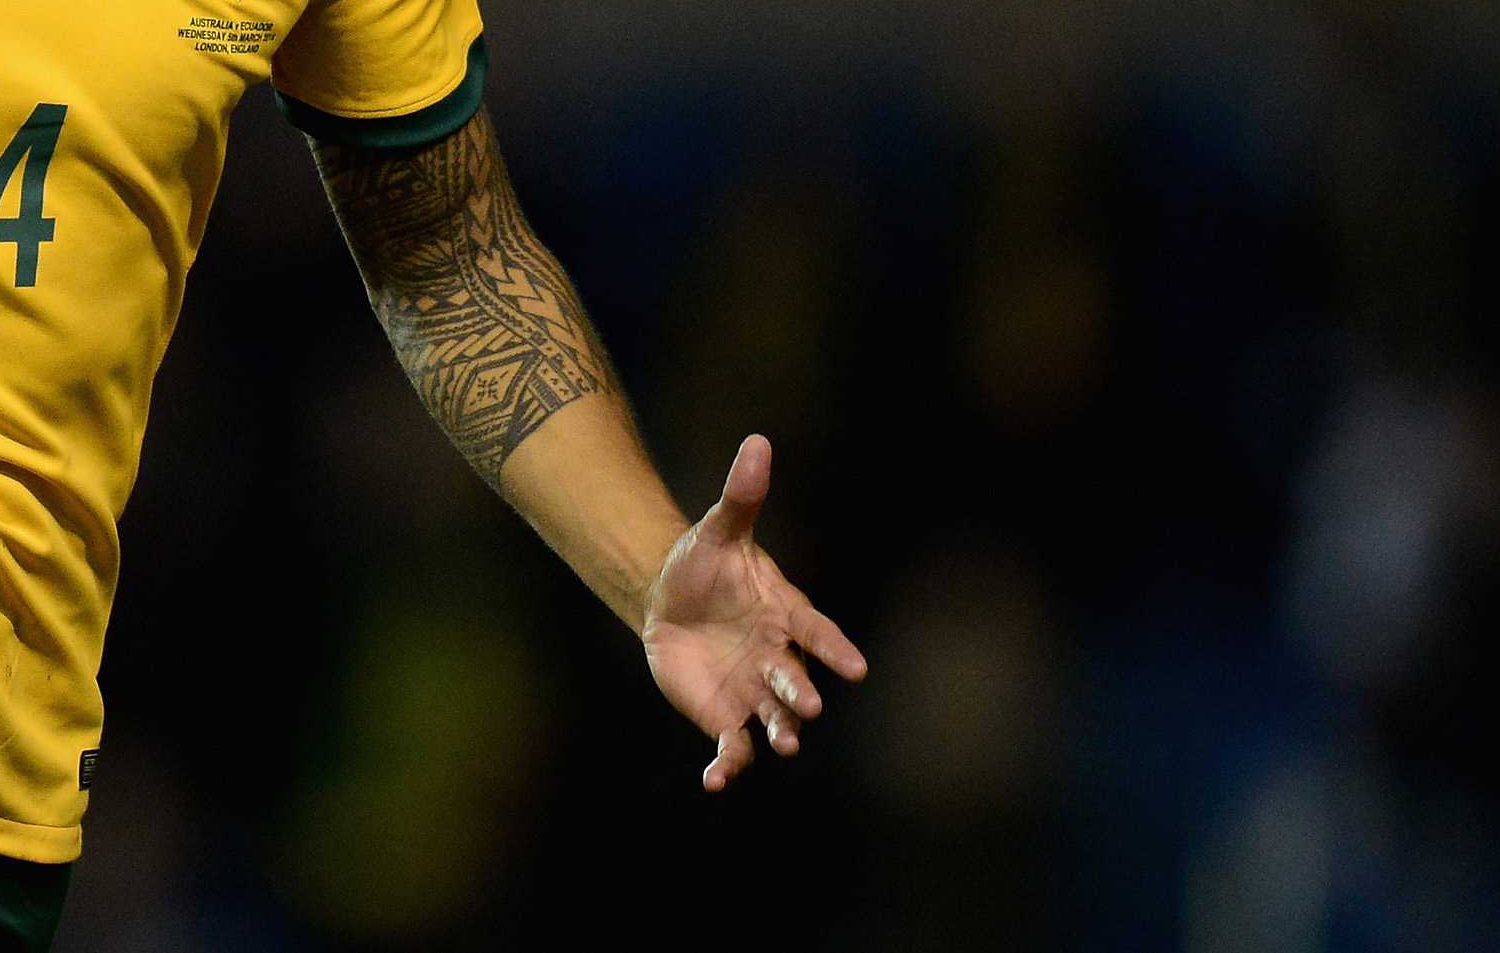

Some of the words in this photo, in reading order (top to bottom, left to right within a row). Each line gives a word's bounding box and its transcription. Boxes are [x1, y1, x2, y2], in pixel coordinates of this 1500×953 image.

[190, 18, 233, 29] AUSTRALIA
[240, 21, 274, 32] ECUADOR
[178, 29, 226, 41] WEDNESDAY
[239, 33, 262, 42] MARCH
[195, 42, 229, 54] LONDON,
[231, 45, 260, 53] ENGLAND
